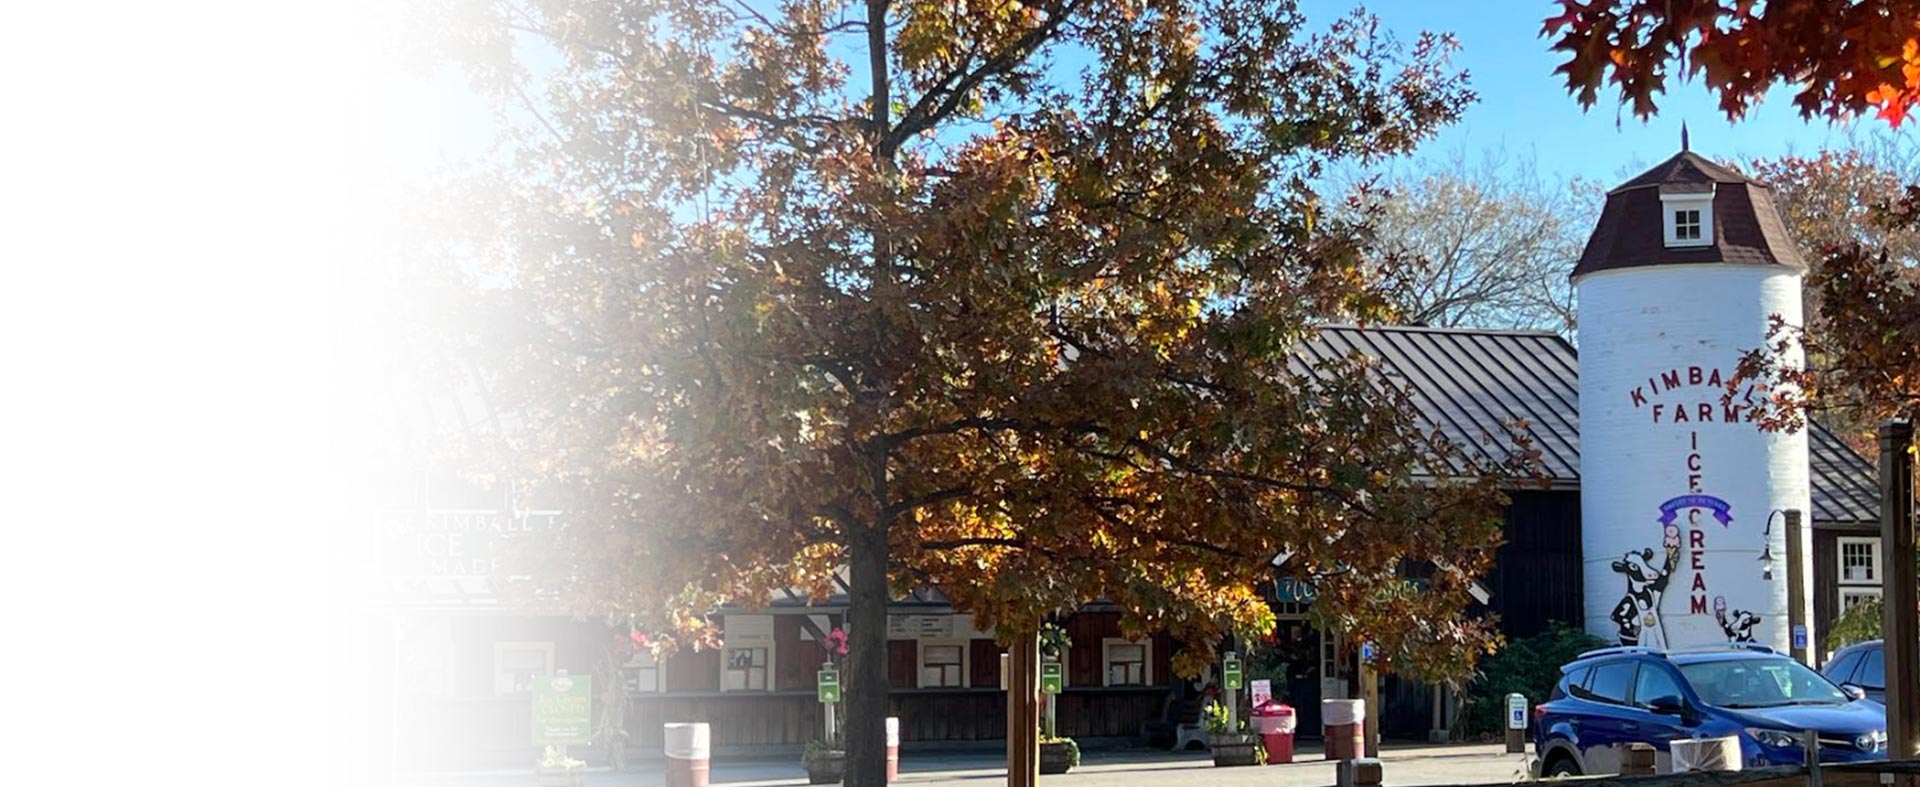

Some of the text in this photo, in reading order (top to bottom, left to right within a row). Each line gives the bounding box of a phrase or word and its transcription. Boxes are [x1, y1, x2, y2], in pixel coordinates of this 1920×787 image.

[1653, 403, 1739, 423] FARM
[427, 515, 532, 532] KIMBALL
[1687, 431, 1707, 615] ICE CREAM
[416, 533, 465, 557] ICE
